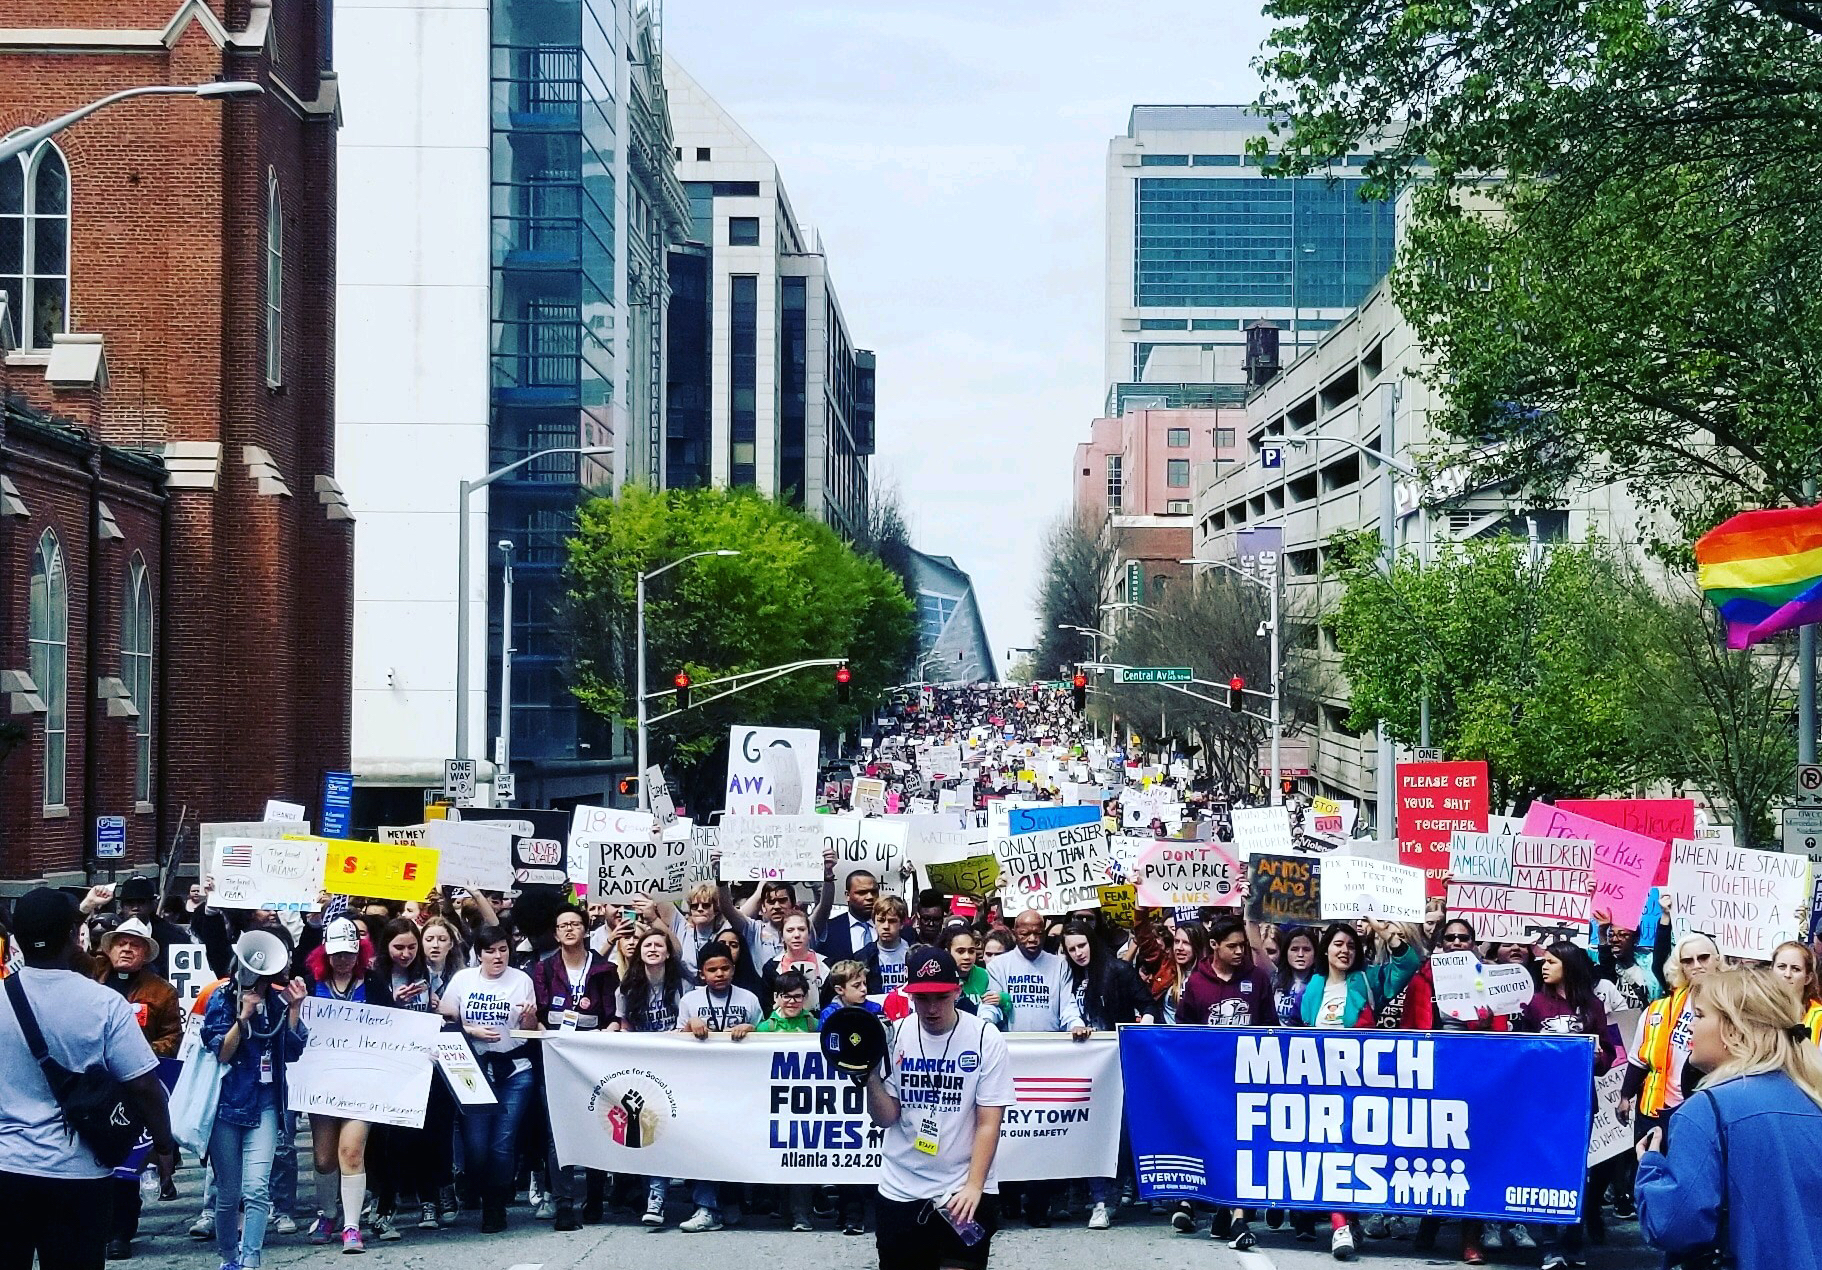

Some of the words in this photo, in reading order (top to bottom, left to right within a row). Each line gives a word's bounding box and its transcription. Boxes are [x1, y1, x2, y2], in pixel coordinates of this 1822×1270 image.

[1266, 450, 1276, 465] P
[1124, 671, 1153, 681] Central
[1418, 750, 1439, 759] ONE
[450, 762, 471, 771] ONE
[450, 772, 471, 782] WAY
[1403, 776, 1449, 788] PLEASE
[1455, 776, 1477, 788] GET
[1313, 800, 1340, 815] STOP
[1404, 798, 1434, 809] YOUR
[1443, 798, 1471, 811] SHIT
[581, 809, 607, 833] 18
[1315, 819, 1342, 831] GUN
[1415, 820, 1477, 831] TOGETHER
[387, 830, 405, 839] HEY
[406, 830, 425, 839] HEY
[753, 835, 783, 849] SHOT
[999, 836, 1037, 858] ONLY
[1058, 824, 1104, 847] EASIER
[823, 820, 868, 862] ands
[876, 843, 898, 871] up
[1301, 837, 1330, 853] Violen
[1401, 840, 1422, 853] IT'S
[1430, 841, 1451, 853] COS
[1453, 835, 1466, 851] IN
[1475, 836, 1507, 856] OUR
[601, 843, 657, 865] PROUD
[663, 842, 685, 856] TO
[1002, 858, 1025, 877] TO
[1028, 852, 1053, 871] BUY
[1057, 845, 1085, 865] THAN
[1089, 844, 1098, 858] A
[1163, 848, 1210, 861] DON'T
[1514, 841, 1593, 869] CHILDREN
[1452, 855, 1510, 879] AMERICA
[1673, 844, 1719, 866] WHEN
[1725, 850, 1746, 872] WE
[1752, 854, 1807, 879] STAND
[266, 865, 298, 876] DREAMS
[598, 865, 616, 879] BE
[621, 864, 635, 876] A
[749, 867, 785, 881] SHOT
[1145, 863, 1176, 878] PUT
[1176, 864, 1187, 878] A
[1192, 863, 1229, 878] PRICE
[1257, 859, 1310, 881] Arms
[932, 868, 994, 892] RISE
[1018, 871, 1049, 894] GUN
[1054, 866, 1077, 886] IS
[1083, 862, 1093, 881] A
[1269, 876, 1306, 895] Are
[1362, 872, 1386, 882] TEXT
[1391, 876, 1404, 885] MY
[1516, 869, 1589, 894] MATTER
[1696, 870, 1780, 900] TOGETHER
[598, 878, 669, 897] RADICAL
[1162, 881, 1178, 892] ON
[1185, 880, 1211, 891] OUR
[1344, 884, 1365, 892] MOM
[1171, 892, 1210, 904] LIVES
[1456, 885, 1516, 912] MORE
[1528, 891, 1588, 919] THAN
[1324, 902, 1360, 912] UNDER
[1367, 903, 1374, 912] A
[1676, 892, 1697, 916] WE
[1710, 898, 1759, 921] STAND
[1768, 904, 1781, 926] A
[1700, 919, 1765, 951] CHANCE
[880, 963, 906, 974] ARCH
[1432, 956, 1469, 967] ENOUGH!
[1008, 974, 1044, 984] MARCH
[1007, 985, 1028, 994] FOR
[1028, 985, 1050, 995] OUR
[1488, 980, 1530, 996] ENOUGH!
[469, 992, 497, 1002] MAR
[1012, 994, 1035, 1004] IVES
[466, 1001, 488, 1010] FOR
[489, 1001, 511, 1012] OUR
[465, 1010, 495, 1021] LIVES
[326, 1034, 351, 1049] are
[901, 1057, 956, 1073] MARCH
[1235, 1036, 1435, 1090] MARCH
[901, 1073, 931, 1088] FOR
[933, 1074, 964, 1090] OUR
[600, 1068, 631, 1087] Alliance
[632, 1067, 645, 1076] for
[645, 1070, 667, 1089] Social
[665, 1089, 677, 1119] Justice
[769, 1085, 837, 1115] FOR
[901, 1088, 941, 1104] LIVES
[1001, 1107, 1090, 1125] RYTOWN
[1236, 1092, 1345, 1144] FOR
[1352, 1095, 1470, 1150] OUR
[769, 1119, 864, 1150] LIVES
[1009, 1129, 1031, 1138] GUN
[1033, 1128, 1069, 1138] SAFETY
[781, 1151, 828, 1168] Atlanta
[831, 1153, 882, 1168] 3.24.20
[1141, 1172, 1207, 1186] EVERYTOWN
[1236, 1150, 1388, 1204] LIVES
[1505, 1186, 1578, 1209] GIFFORDS
